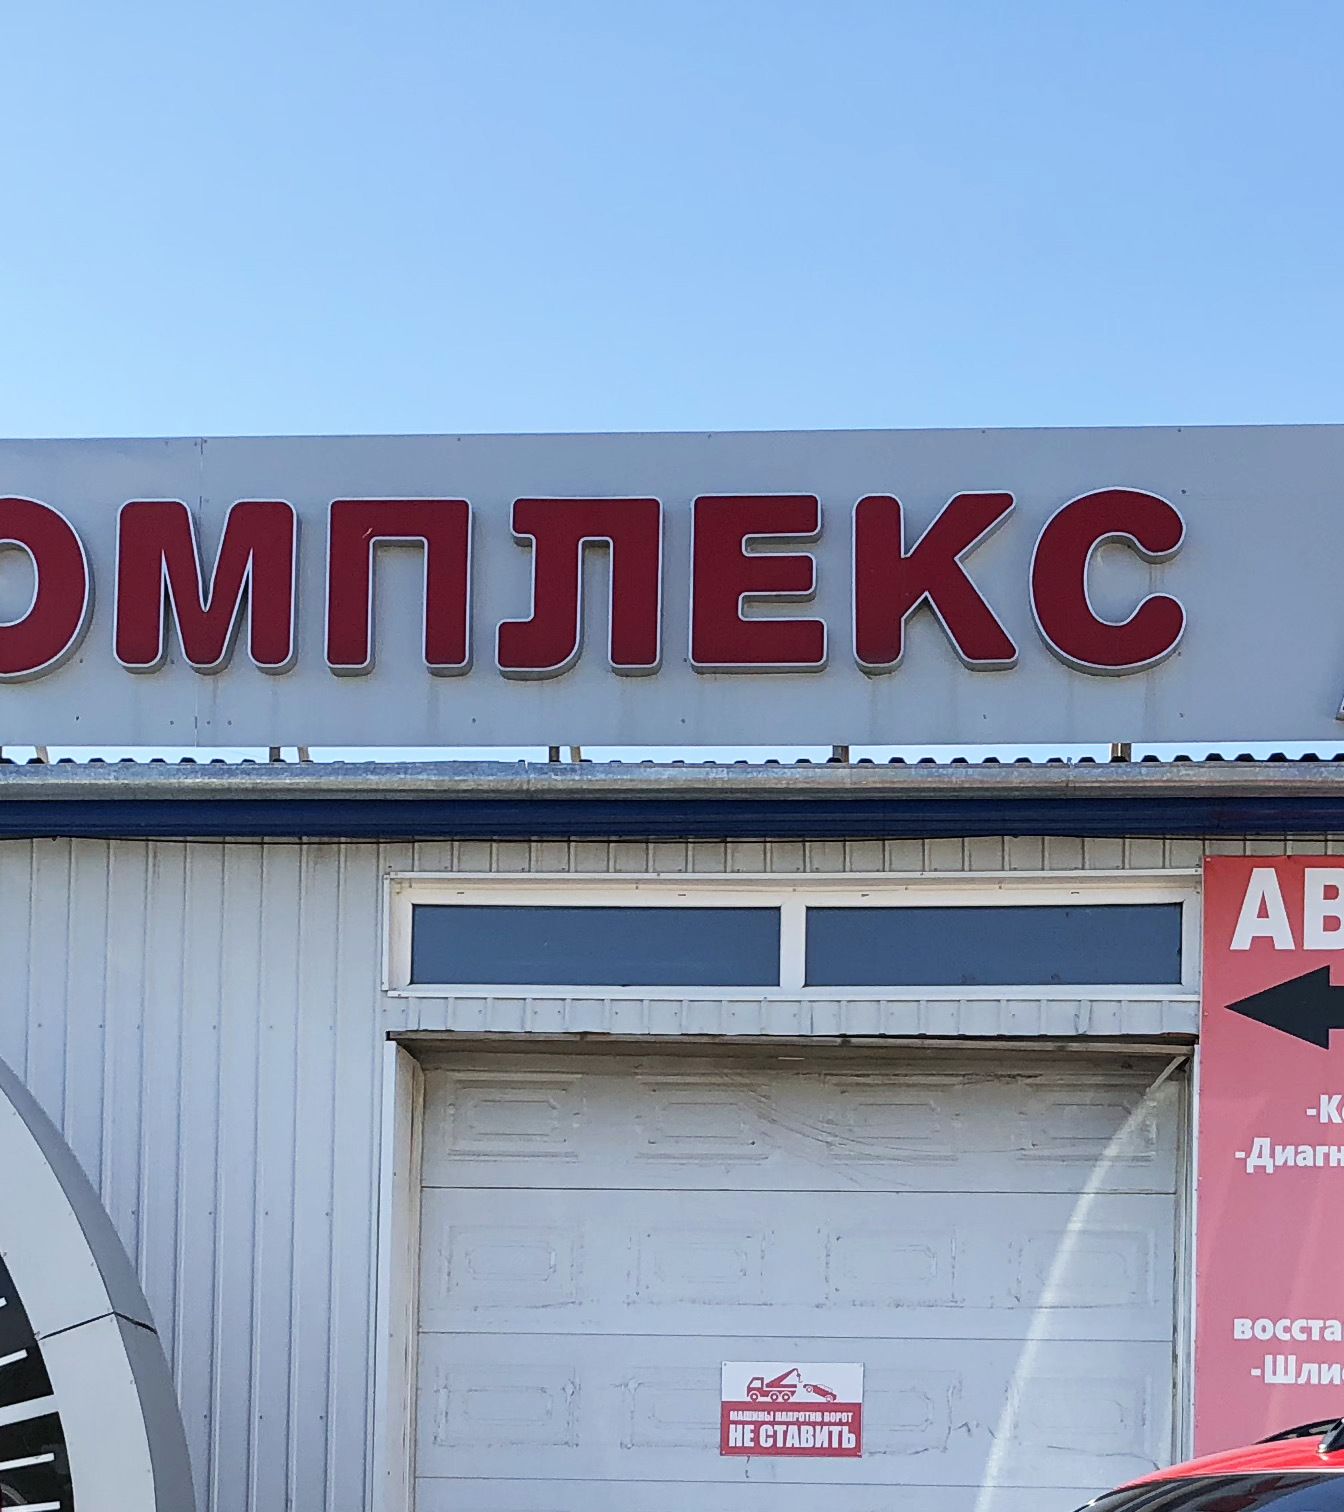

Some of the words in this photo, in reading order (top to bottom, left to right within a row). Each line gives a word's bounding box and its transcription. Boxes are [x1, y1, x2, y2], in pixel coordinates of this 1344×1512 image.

[729, 1410, 774, 1422] МАШИНЫ
[775, 1411, 823, 1423] НАПРОТИВ
[824, 1411, 854, 1423] ВОРОТ
[728, 1424, 755, 1448] НЕ
[759, 1424, 857, 1449] СТАВИТЬ
